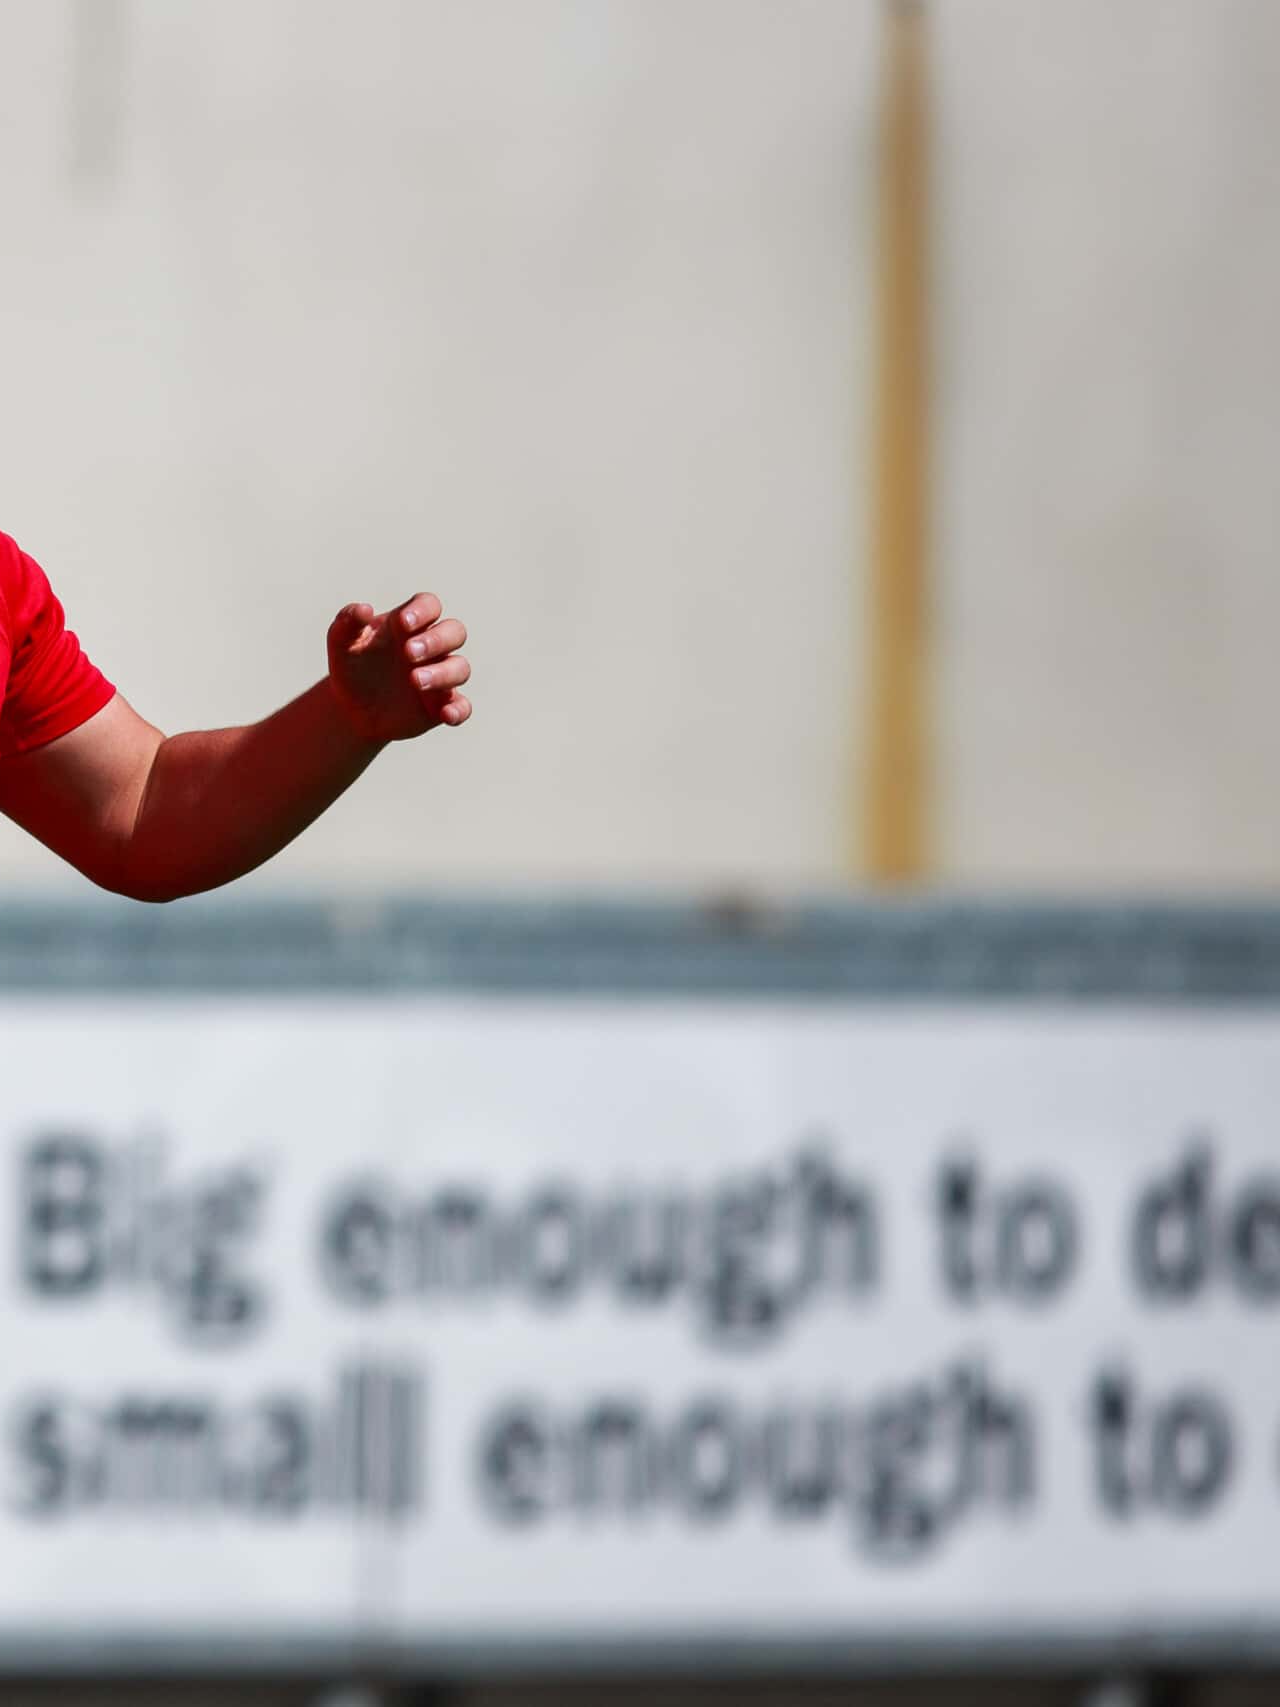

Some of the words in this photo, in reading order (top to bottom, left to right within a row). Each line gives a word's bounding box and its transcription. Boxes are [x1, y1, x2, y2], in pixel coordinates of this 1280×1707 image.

[20, 1125, 265, 1343] Big
[320, 1132, 877, 1345] enough
[935, 1140, 1080, 1308] to
[10, 1355, 425, 1520] small
[477, 1358, 1035, 1562] enough
[1092, 1362, 1233, 1520] to
